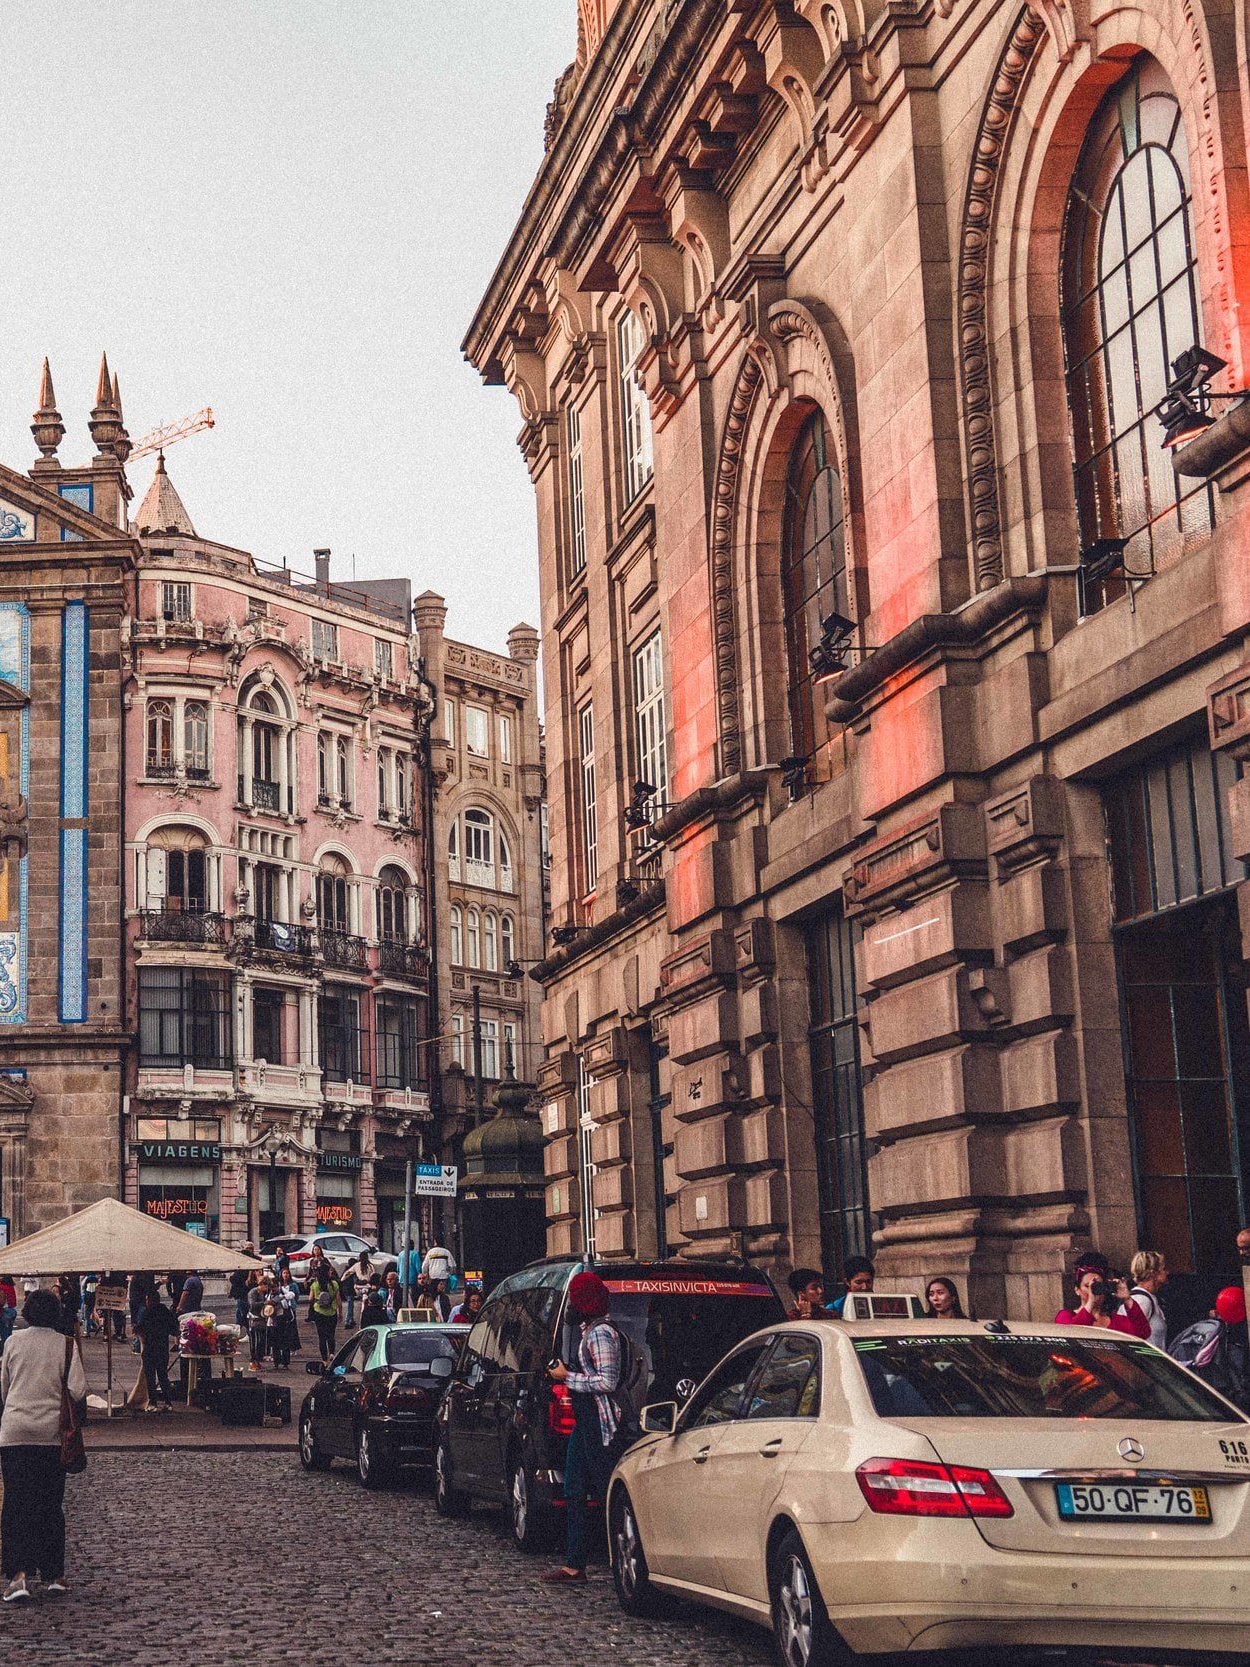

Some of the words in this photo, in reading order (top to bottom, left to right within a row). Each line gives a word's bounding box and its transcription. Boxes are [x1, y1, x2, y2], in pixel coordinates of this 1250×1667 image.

[144, 1145, 220, 1158] VIAGENS
[321, 1154, 361, 1168] TURISMO
[418, 1166, 440, 1175] TAXIS
[634, 1281, 717, 1292] TAXISINVICTA
[1218, 1440, 1248, 1455] 616
[1225, 1454, 1250, 1464] PORTO
